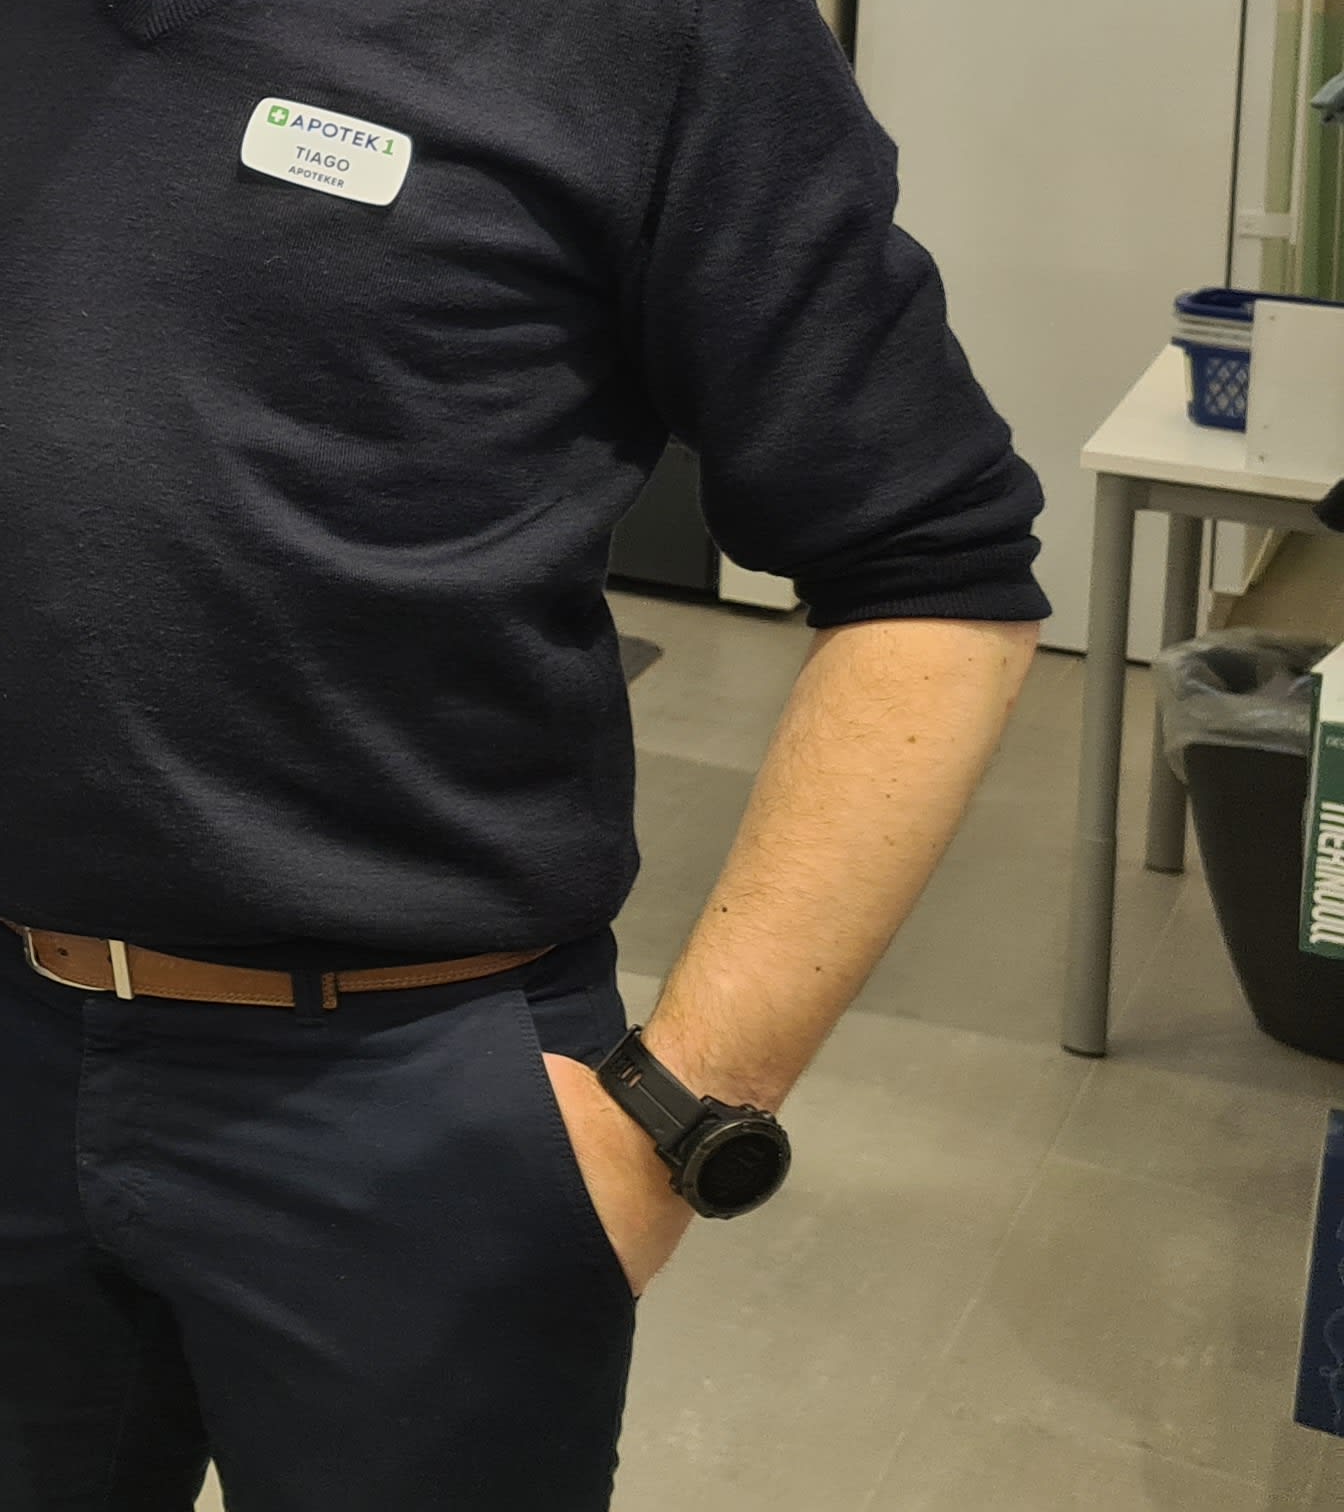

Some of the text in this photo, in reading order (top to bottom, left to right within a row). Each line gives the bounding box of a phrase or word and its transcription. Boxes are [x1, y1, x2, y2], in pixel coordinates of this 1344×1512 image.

[289, 115, 394, 155] APOTEK 1
[296, 145, 350, 172] TIAGO
[288, 165, 345, 188] APOTEKER
